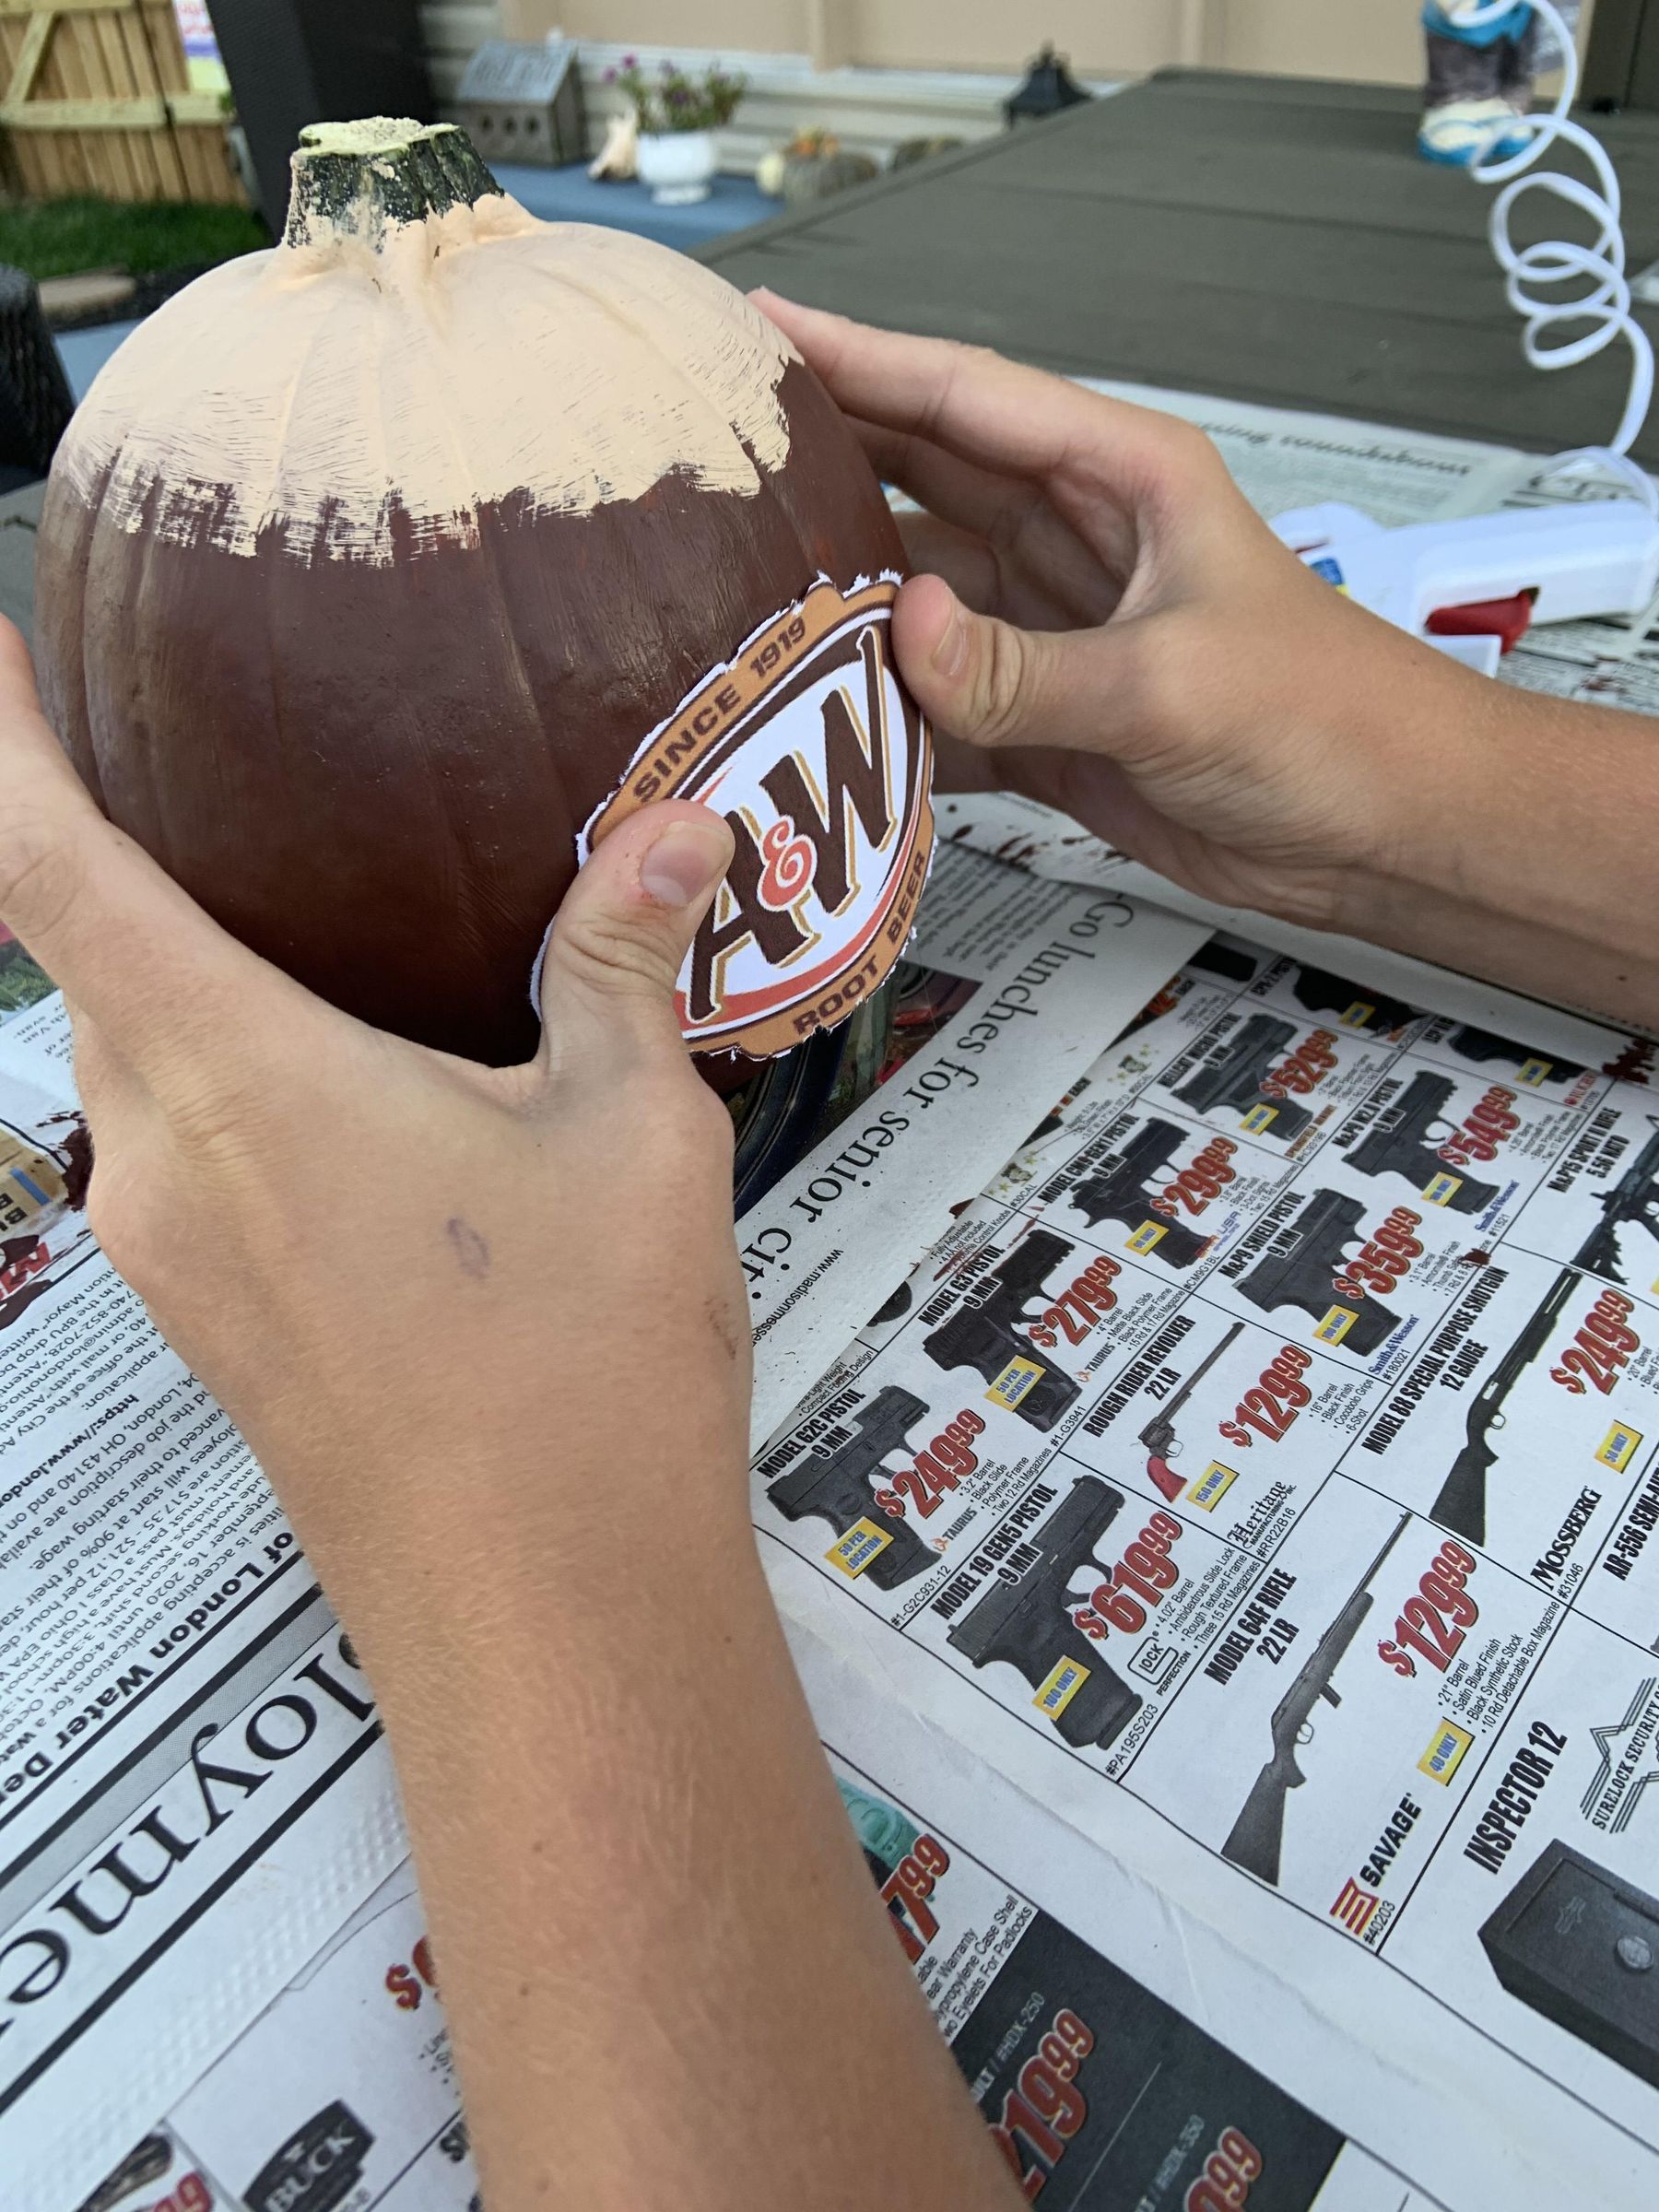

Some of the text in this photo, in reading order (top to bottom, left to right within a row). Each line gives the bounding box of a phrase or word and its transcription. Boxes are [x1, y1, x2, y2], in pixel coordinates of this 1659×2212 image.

[633, 617, 806, 803] SINCE 1919
[685, 625, 897, 1023] A&W
[1069, 892, 1135, 938] Go
[793, 850, 925, 1038] ROOT BEER
[956, 938, 1097, 1053] lunches
[902, 1057, 980, 1109] for
[1067, 1077, 1091, 1098] EACH
[1368, 1077, 1404, 1106] PISTOL
[1037, 1173, 1077, 1204] MODEL
[1065, 1156, 1094, 1177] CM9
[1101, 1112, 1140, 1142] PISTOL
[1568, 1133, 1602, 1163] SPORT
[1592, 1107, 1622, 1130] RIFLE
[1585, 1135, 1630, 1179] 5.56 NATO
[788, 1111, 910, 1223] senior
[1098, 1153, 1125, 1171] MM
[1009, 1184, 1038, 1208] #30CAL
[943, 1219, 974, 1247] Adjustable
[1218, 1191, 1306, 1279] M&P9 SHIELD PISTOL
[1273, 1229, 1301, 1250] MM
[739, 1227, 792, 1300] cit
[917, 1243, 1006, 1327] MODEL G3 PISTOL
[970, 1276, 1000, 1300] MM
[1182, 1255, 1221, 1290] #CM9G1BL
[80, 1350, 159, 1411] application:
[1081, 1314, 1196, 1438] ROUGH RIDER REVOLVER
[1084, 1342, 1116, 1372] TAURUS
[1360, 1265, 1509, 1455] MODEL 88 SPECIAL PURPOSE SHOTGUN
[1382, 1348, 1411, 1382] #180021
[1439, 1338, 1488, 1392] 12 GAUGE
[123, 1388, 182, 1431] London,
[800, 1389, 832, 1418] Compact
[1007, 1371, 1035, 1403] LOCATION
[1144, 1367, 1182, 1402] 22 LR
[756, 1388, 867, 1479] MODEL G2C PISTOL
[1050, 1406, 1087, 1448] #1-G3941
[1334, 1395, 1362, 1426] Cocobolo
[819, 1425, 853, 1451] MM
[67, 1442, 146, 1507] description
[1018, 1447, 1053, 1482] Magazines
[1207, 1471, 1224, 1489] ONLY
[72, 1488, 130, 1535] starting
[129, 1486, 164, 1516] start
[982, 1478, 1011, 1507] Polymer
[1227, 1481, 1295, 1547] Heritage
[172, 1496, 226, 1541] holidays.
[182, 1501, 240, 1550] working
[941, 1506, 978, 1541] TAURUS
[1249, 1500, 1285, 1546] MANUFACTURING
[1255, 1507, 1297, 1559] #RR22B16
[1529, 1487, 1603, 1592] MOSSBERG
[850, 1537, 881, 1570] LOCATION
[930, 1483, 1059, 1620] MODEL 19 GEN5 PISTOL
[996, 1542, 1041, 1584] 9 MM
[1602, 1524, 1648, 1582] AR-556
[890, 1564, 952, 1627] #1-G2C931-12
[1227, 1560, 1261, 1600] Magazines
[1557, 1562, 1584, 1600] #31046
[148, 1562, 264, 1659] London
[1169, 1583, 1210, 1631] Ambidextrous
[1181, 1577, 1230, 1639] Rough Textured
[1203, 1567, 1297, 1686] MODEL 64F RIFLE
[49, 1547, 235, 1718] accepting applications for
[1255, 1618, 1300, 1665] 22 LR
[1057, 1669, 1077, 1692] ONLY
[1156, 1650, 1192, 1697] PERFECTION
[1446, 1658, 1470, 1688] Barrel
[1452, 1638, 1501, 1712] Satin Blued Finish
[1465, 1633, 1524, 1721] Black Synthetic Stock
[1487, 1601, 1560, 1718] Rd Detachable Box Magazine
[55, 1664, 155, 1750] Water
[1104, 1703, 1159, 1775] #PA195S203
[1439, 1735, 1457, 1759] ONLY
[1592, 1700, 1659, 1830] SURELOCK SECURITY
[1463, 1721, 1568, 1876] INSPECTOR 12
[1359, 1796, 1422, 1888] SAVAGE
[974, 1894, 1018, 1956] Case Shell
[1362, 1900, 1395, 1946] #40203
[936, 1927, 979, 1979] Warranty
[951, 1906, 1033, 2021] Eyelets Padlocks
[259, 2121, 357, 2212] BUCK
